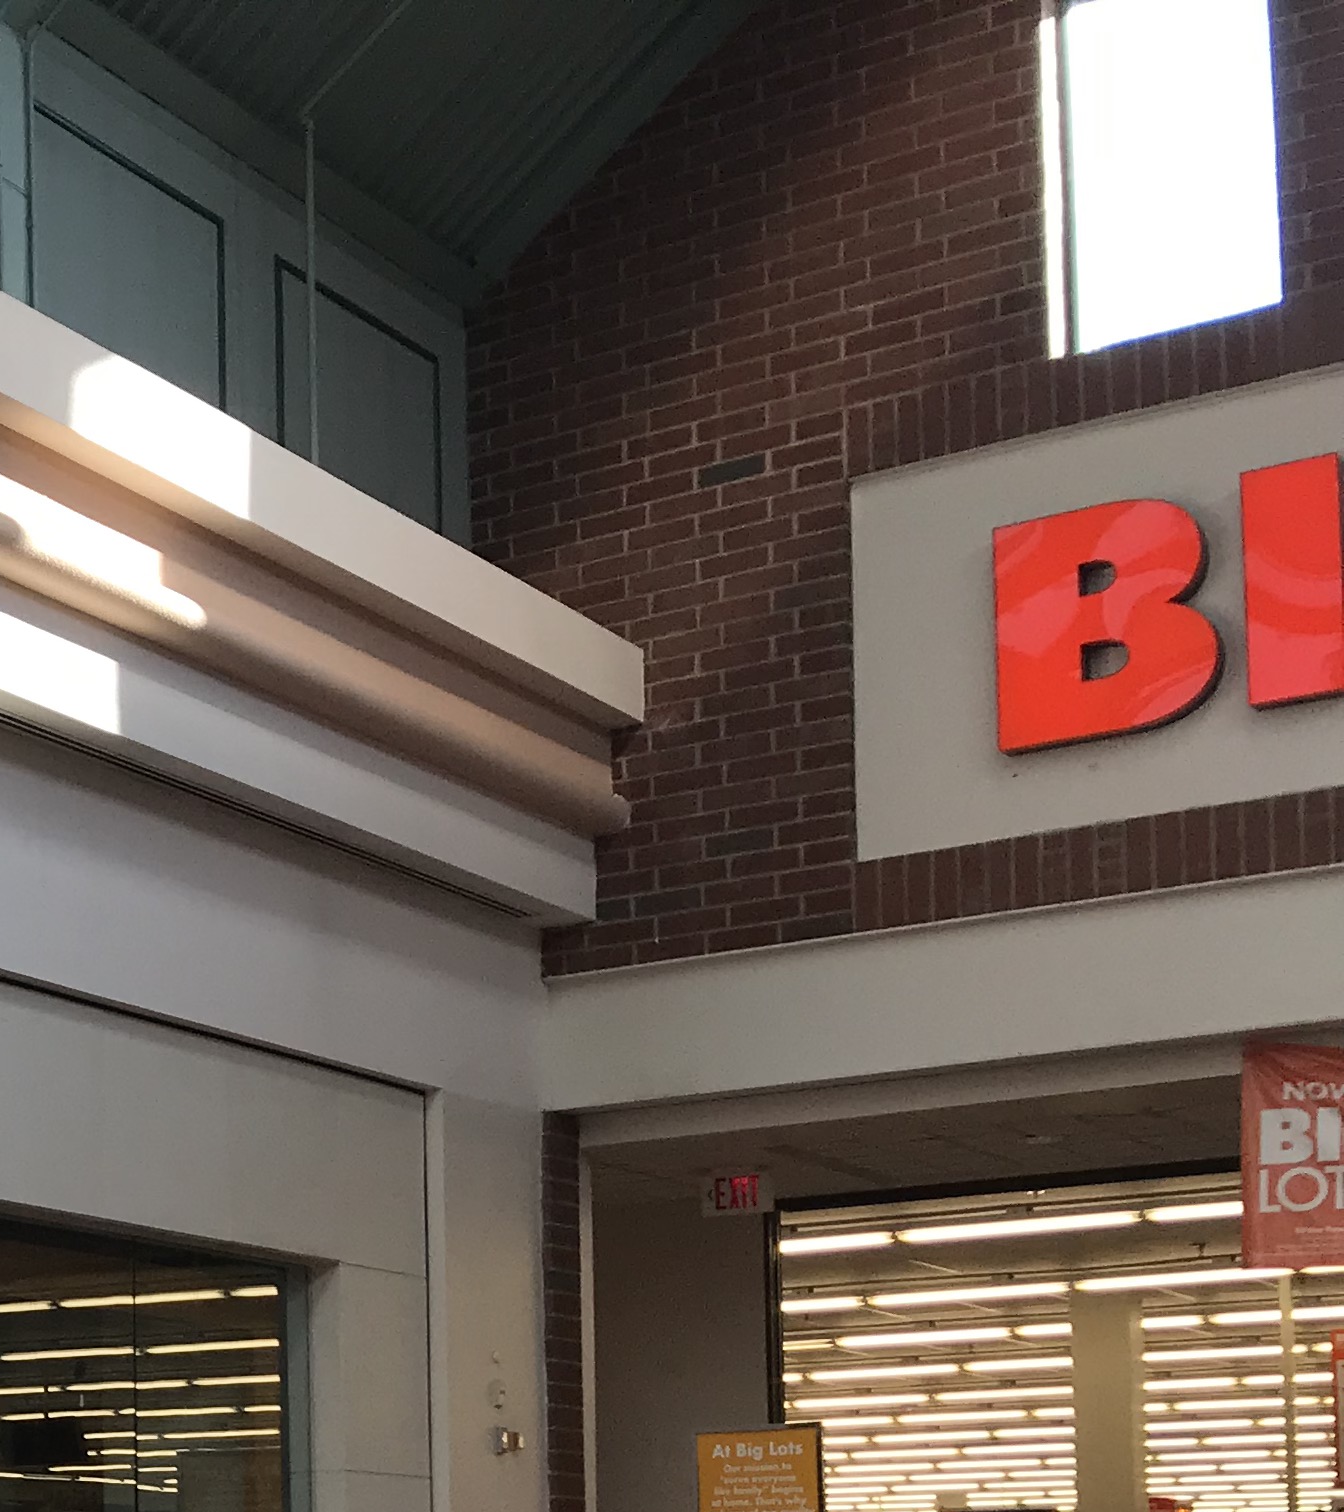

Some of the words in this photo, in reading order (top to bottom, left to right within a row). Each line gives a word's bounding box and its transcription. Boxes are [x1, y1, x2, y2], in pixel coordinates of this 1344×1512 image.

[715, 1174, 759, 1209] EXIT
[712, 1444, 731, 1459] At
[736, 1443, 764, 1460] Big
[769, 1441, 804, 1456] Lots
